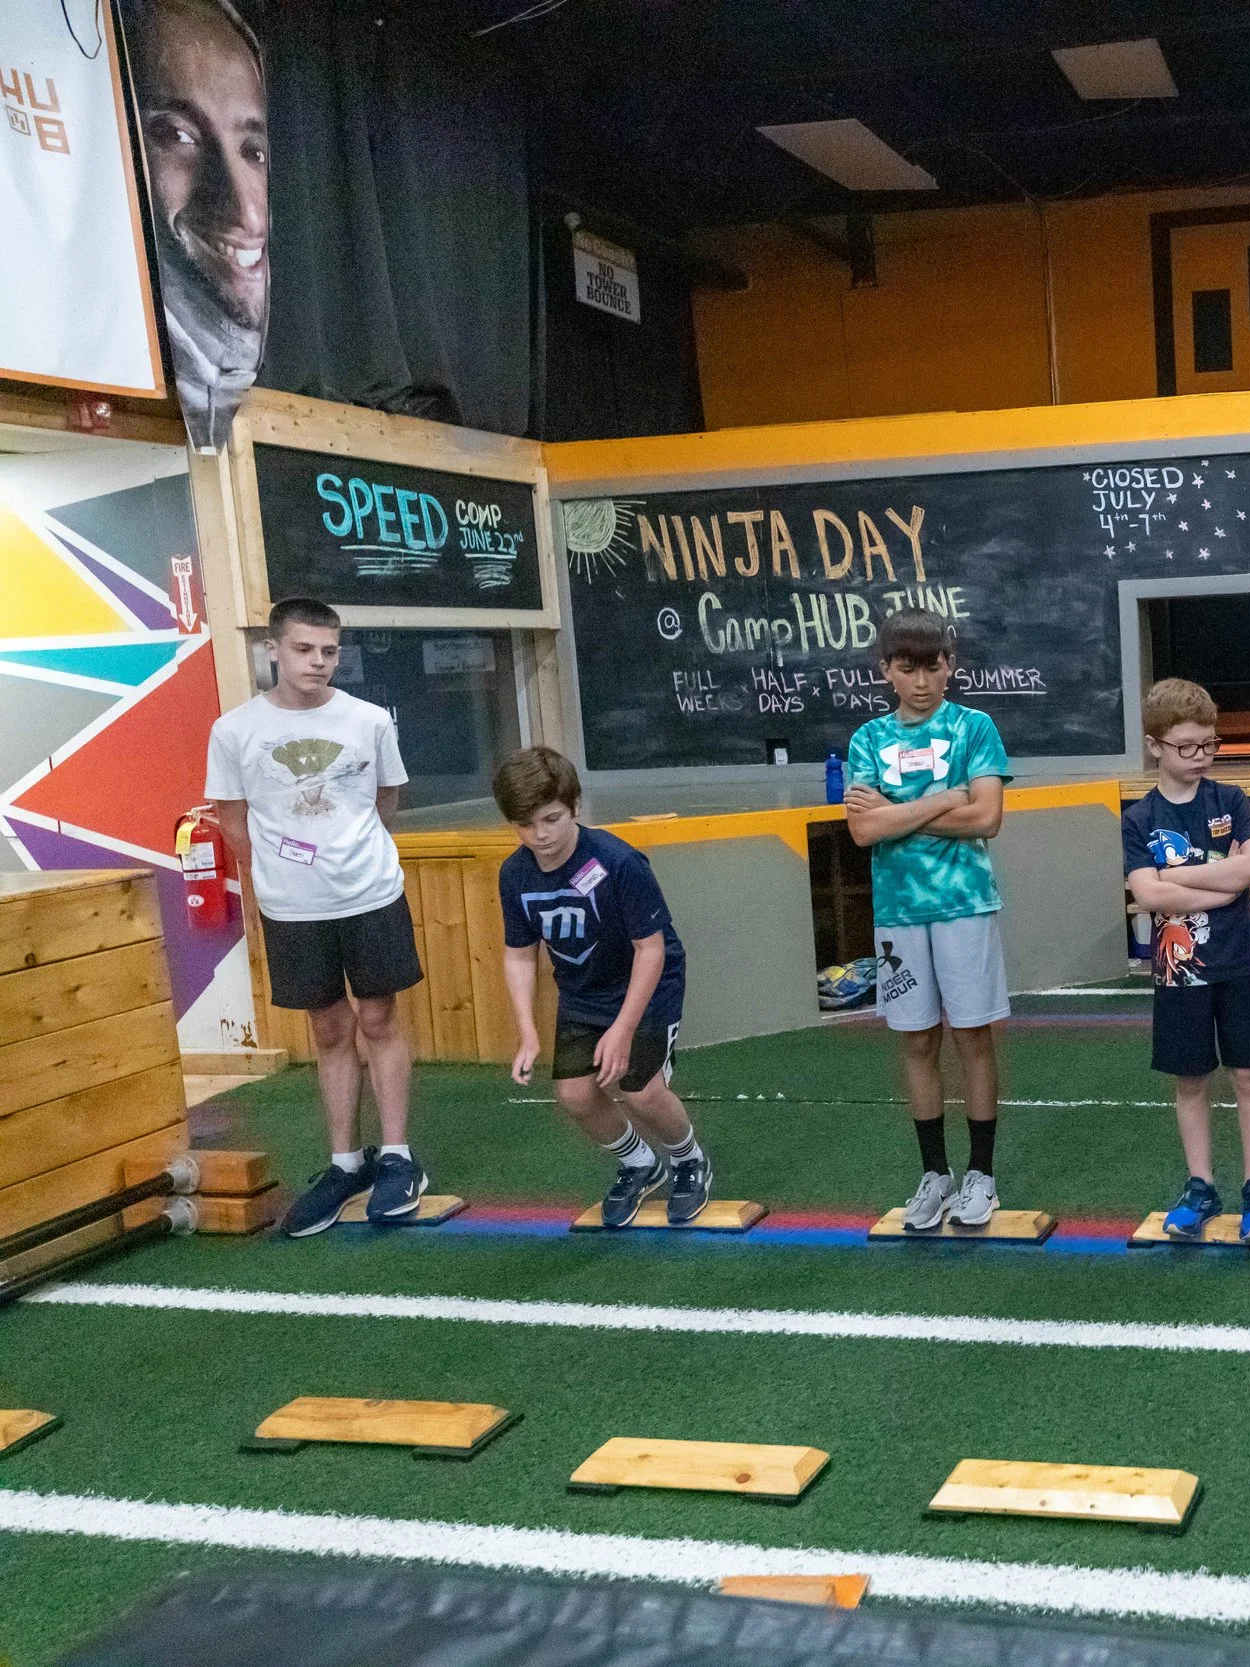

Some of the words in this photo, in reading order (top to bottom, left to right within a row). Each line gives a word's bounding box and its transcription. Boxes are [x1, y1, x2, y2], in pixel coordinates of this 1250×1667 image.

[586, 271, 627, 299] TOWER
[597, 261, 614, 281] NO
[586, 285, 632, 315] BOUNCE
[316, 473, 449, 549] SPEED
[455, 499, 502, 530] COMP
[1092, 490, 1156, 512] JULY
[459, 527, 492, 551] JUNE
[494, 530, 524, 555] 22nd
[637, 510, 801, 581] NINJA
[813, 505, 926, 582] DAY
[174, 561, 191, 574] FIRE
[883, 585, 971, 619] JUNE
[673, 669, 721, 692] FULL
[751, 667, 807, 694] HALF
[827, 668, 889, 688] FULL
[954, 667, 1047, 691] SUMMER
[758, 692, 806, 713] DAYS
[832, 694, 891, 713] DAYS
[881, 968, 913, 992] NDER
[882, 977, 919, 1005] MOUR
